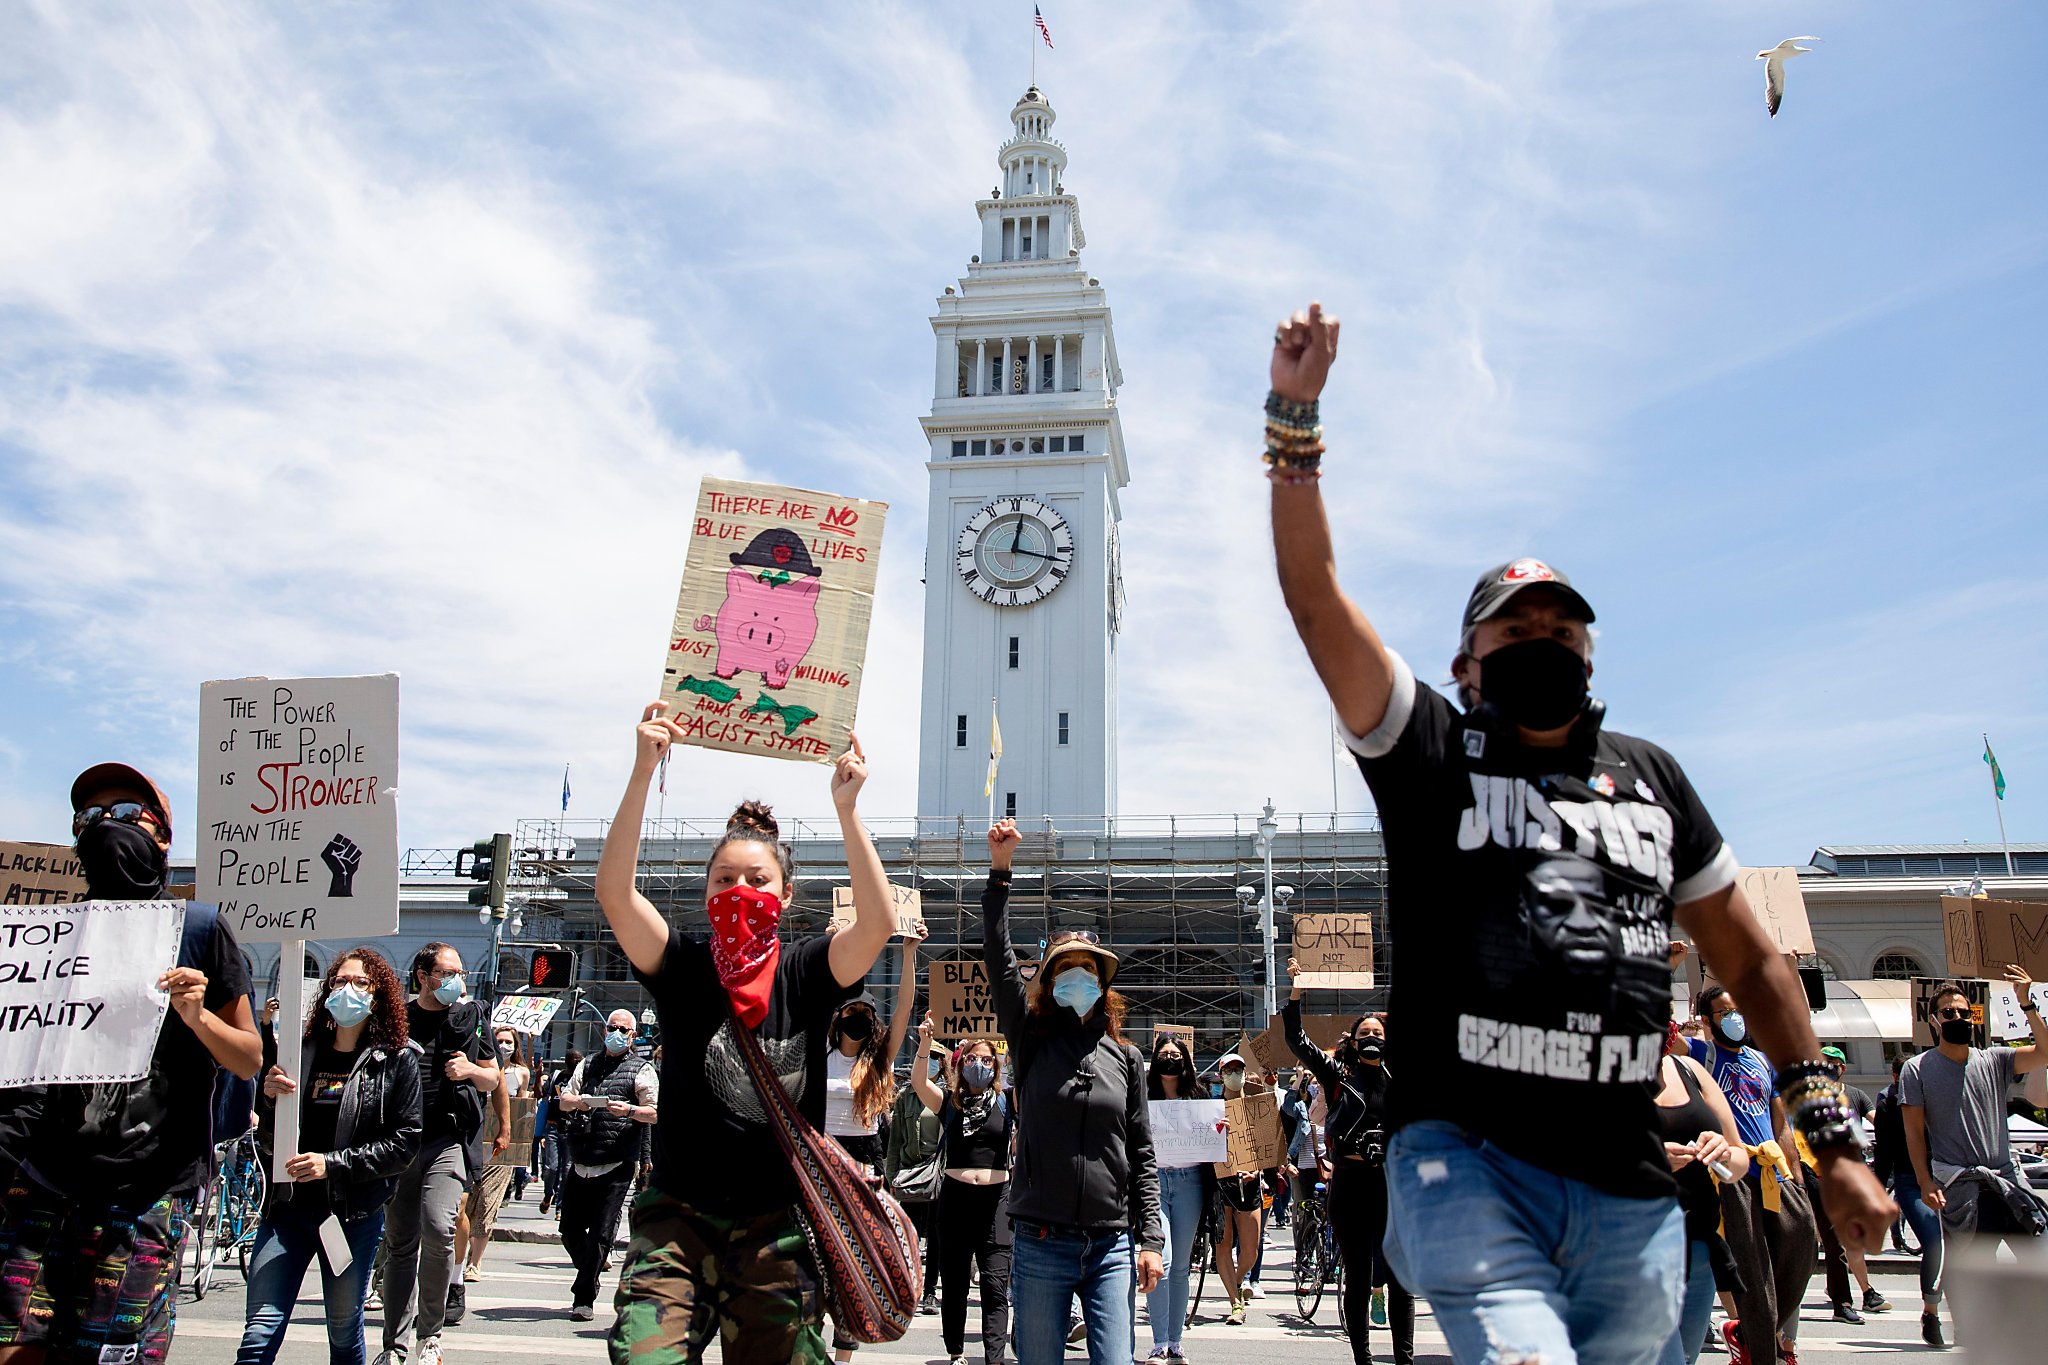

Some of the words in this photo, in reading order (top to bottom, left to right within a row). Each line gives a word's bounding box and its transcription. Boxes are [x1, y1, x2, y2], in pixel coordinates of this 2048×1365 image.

[706, 491, 773, 516] THERE
[776, 499, 818, 520] ARE
[824, 506, 858, 527] NO
[695, 518, 747, 541] BLUE
[811, 538, 868, 563] LIVES
[671, 637, 716, 658] JUST
[223, 697, 258, 719] THE
[273, 687, 336, 725] POWER
[694, 696, 735, 718] ARMS
[738, 708, 758, 723] OF
[760, 713, 774, 726] A
[219, 729, 238, 752] of
[249, 729, 282, 750] THE
[673, 711, 760, 745] RACIST
[763, 730, 831, 755] STATE
[250, 762, 378, 815] STRONGER
[211, 820, 260, 843] THAN
[265, 818, 303, 842] THE
[218, 848, 311, 887] PEOPLE
[217, 899, 239, 914] IN
[240, 903, 317, 931] POWER
[0, 921, 74, 948] TOP
[1294, 916, 1370, 949] CARE
[1322, 953, 1346, 962] NOT
[944, 963, 988, 984] BLA
[1298, 963, 1371, 985] COPS
[493, 1007, 548, 1031] BLACK
[1458, 1013, 1593, 1081] GEORGE
[1228, 1128, 1254, 1145] THE
[94, 1277, 119, 1288] PEPSI
[29, 1307, 55, 1318] PEPS
[115, 1313, 143, 1324] PEPSI
